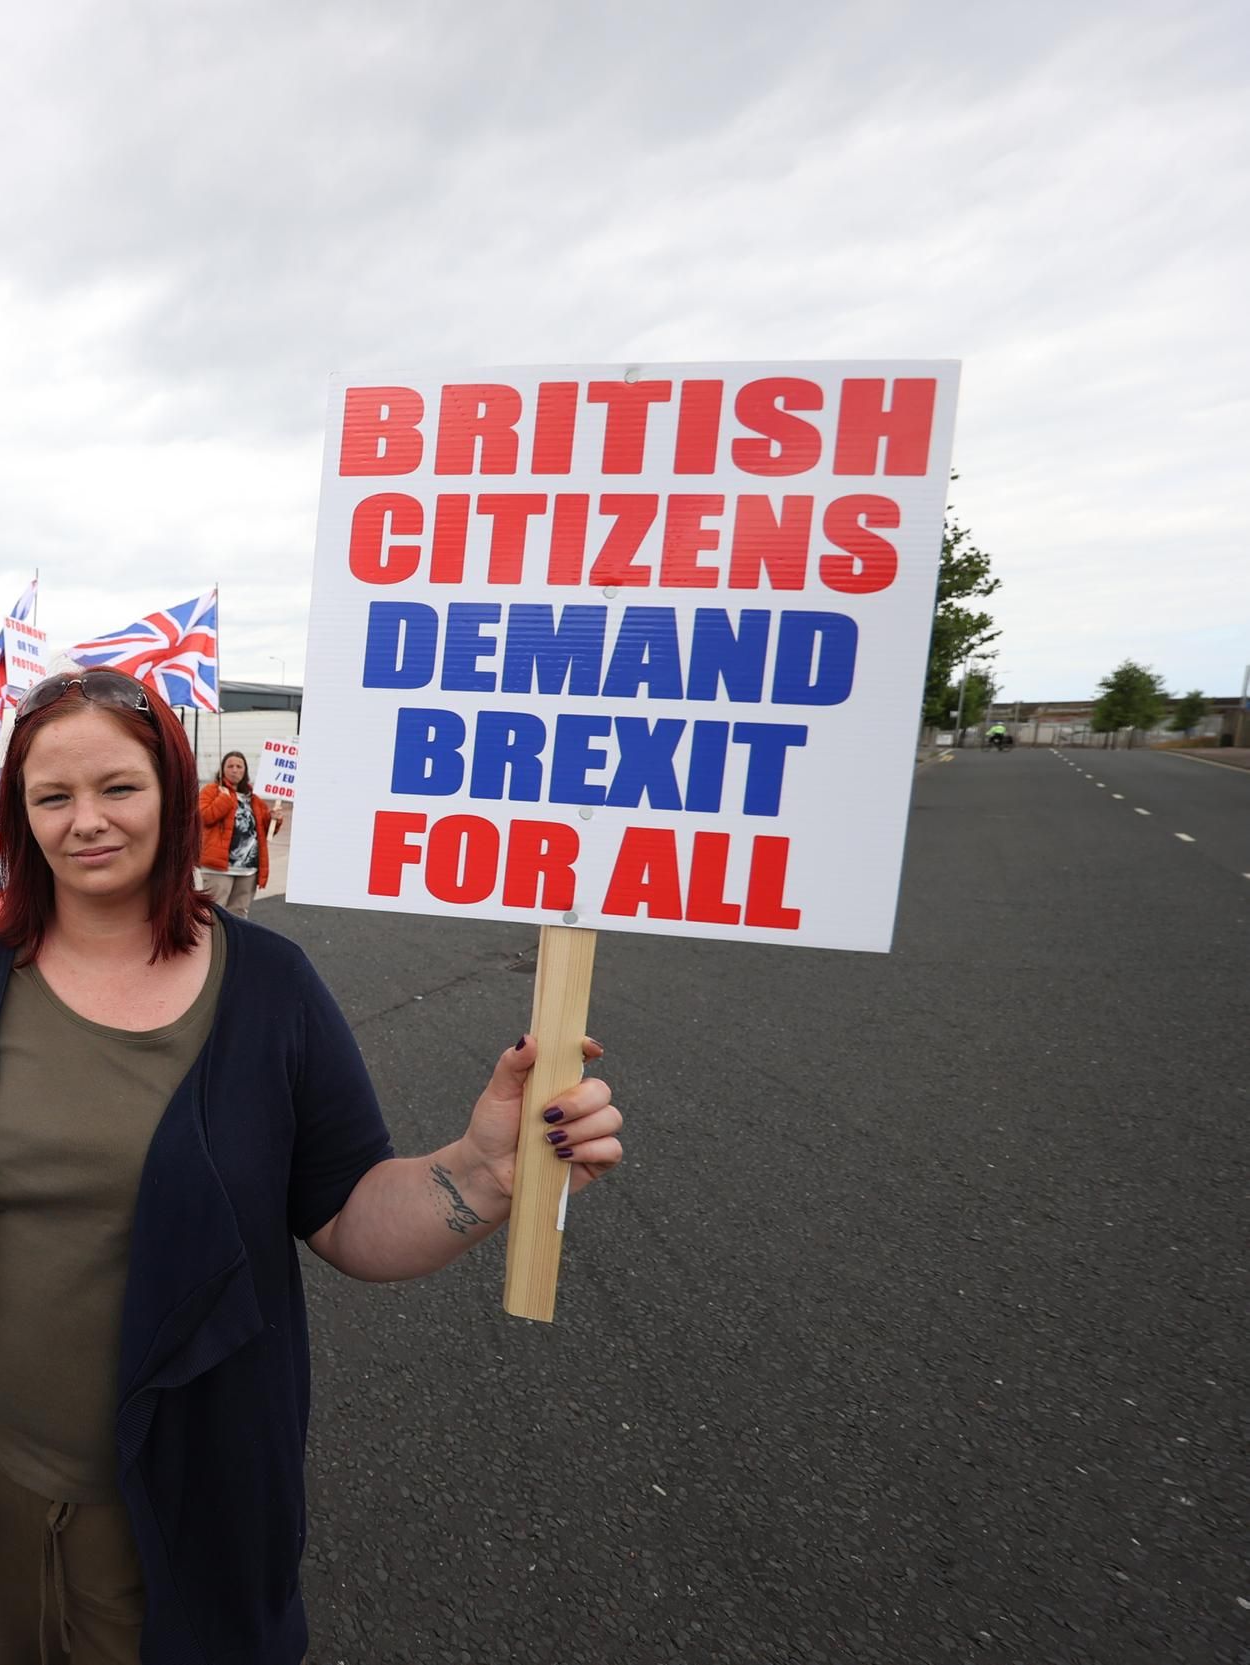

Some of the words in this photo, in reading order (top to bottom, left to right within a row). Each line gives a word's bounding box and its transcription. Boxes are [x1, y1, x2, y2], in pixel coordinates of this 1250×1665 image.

[338, 376, 937, 477] BRITISH
[348, 492, 901, 594] CITIZENS
[5, 617, 47, 641] STORMONT
[362, 600, 859, 706] DEMAND
[264, 741, 299, 756] BOYC
[264, 784, 294, 798] GOOD
[282, 773, 295, 784] EU
[390, 707, 809, 817] BREXIT
[367, 810, 580, 912] FOR
[601, 826, 802, 931] ALL
